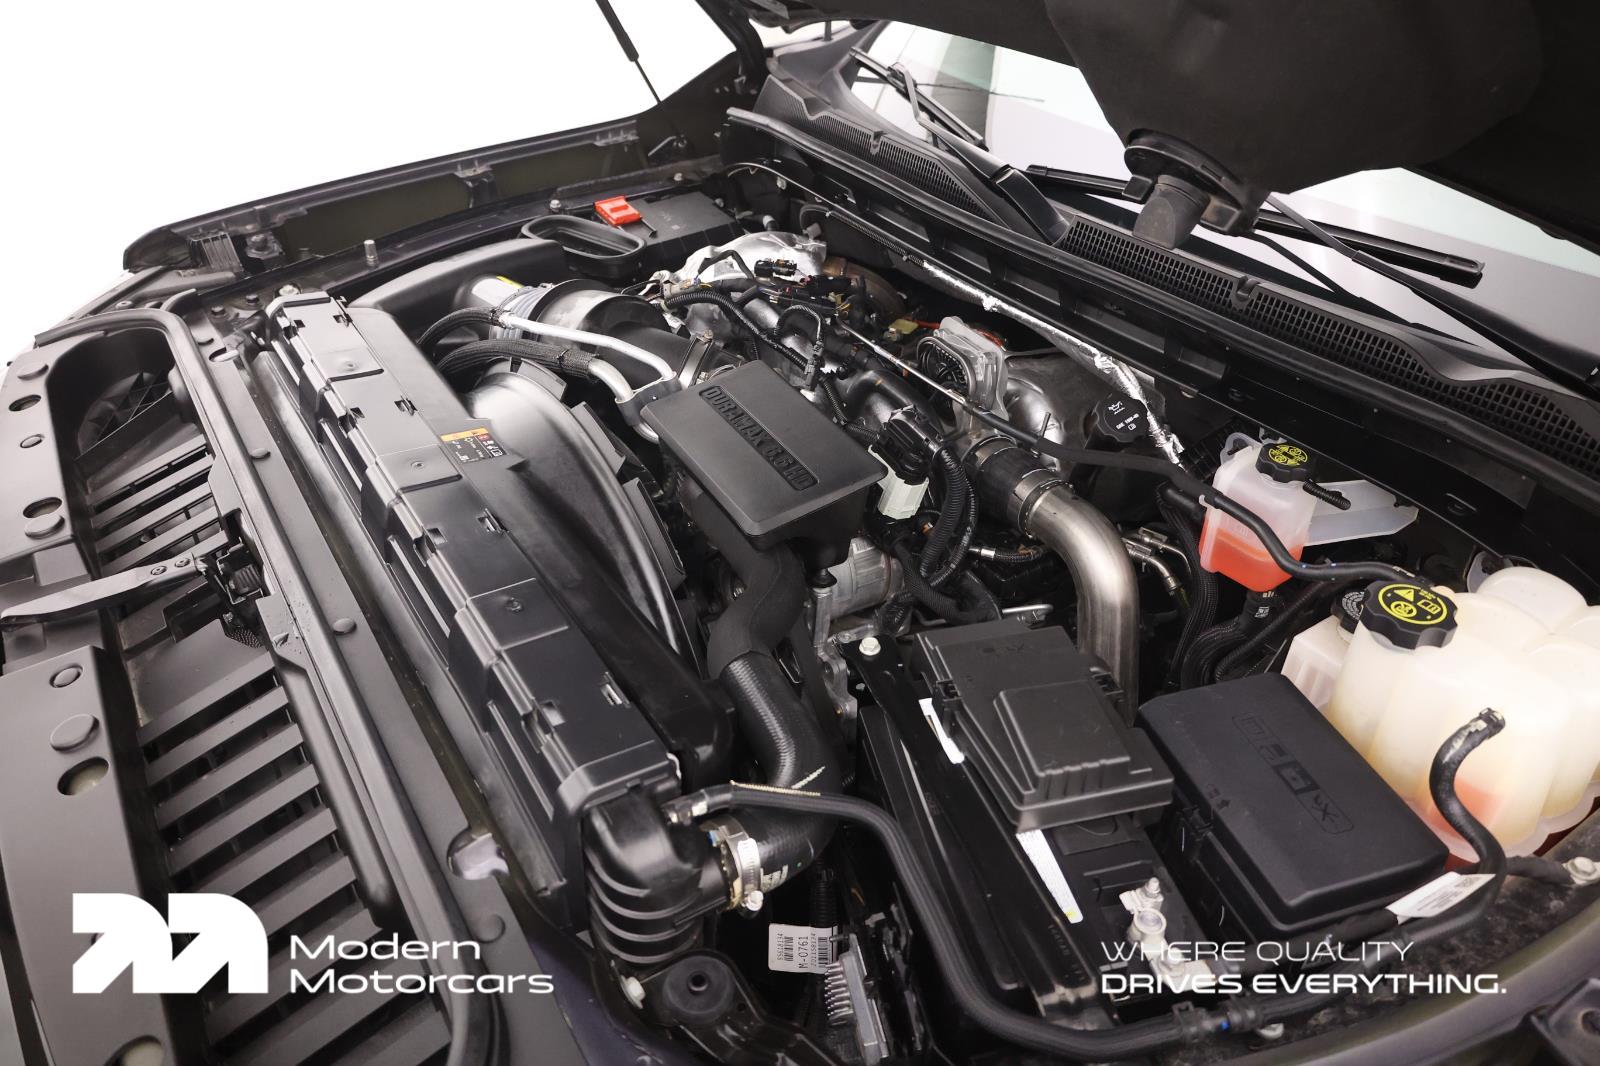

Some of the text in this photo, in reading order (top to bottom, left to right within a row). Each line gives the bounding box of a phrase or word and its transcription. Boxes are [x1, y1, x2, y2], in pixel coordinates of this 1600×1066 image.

[702, 387, 769, 447] DURAMAX
[783, 462, 817, 489] HD
[798, 936, 809, 969] M-0761
